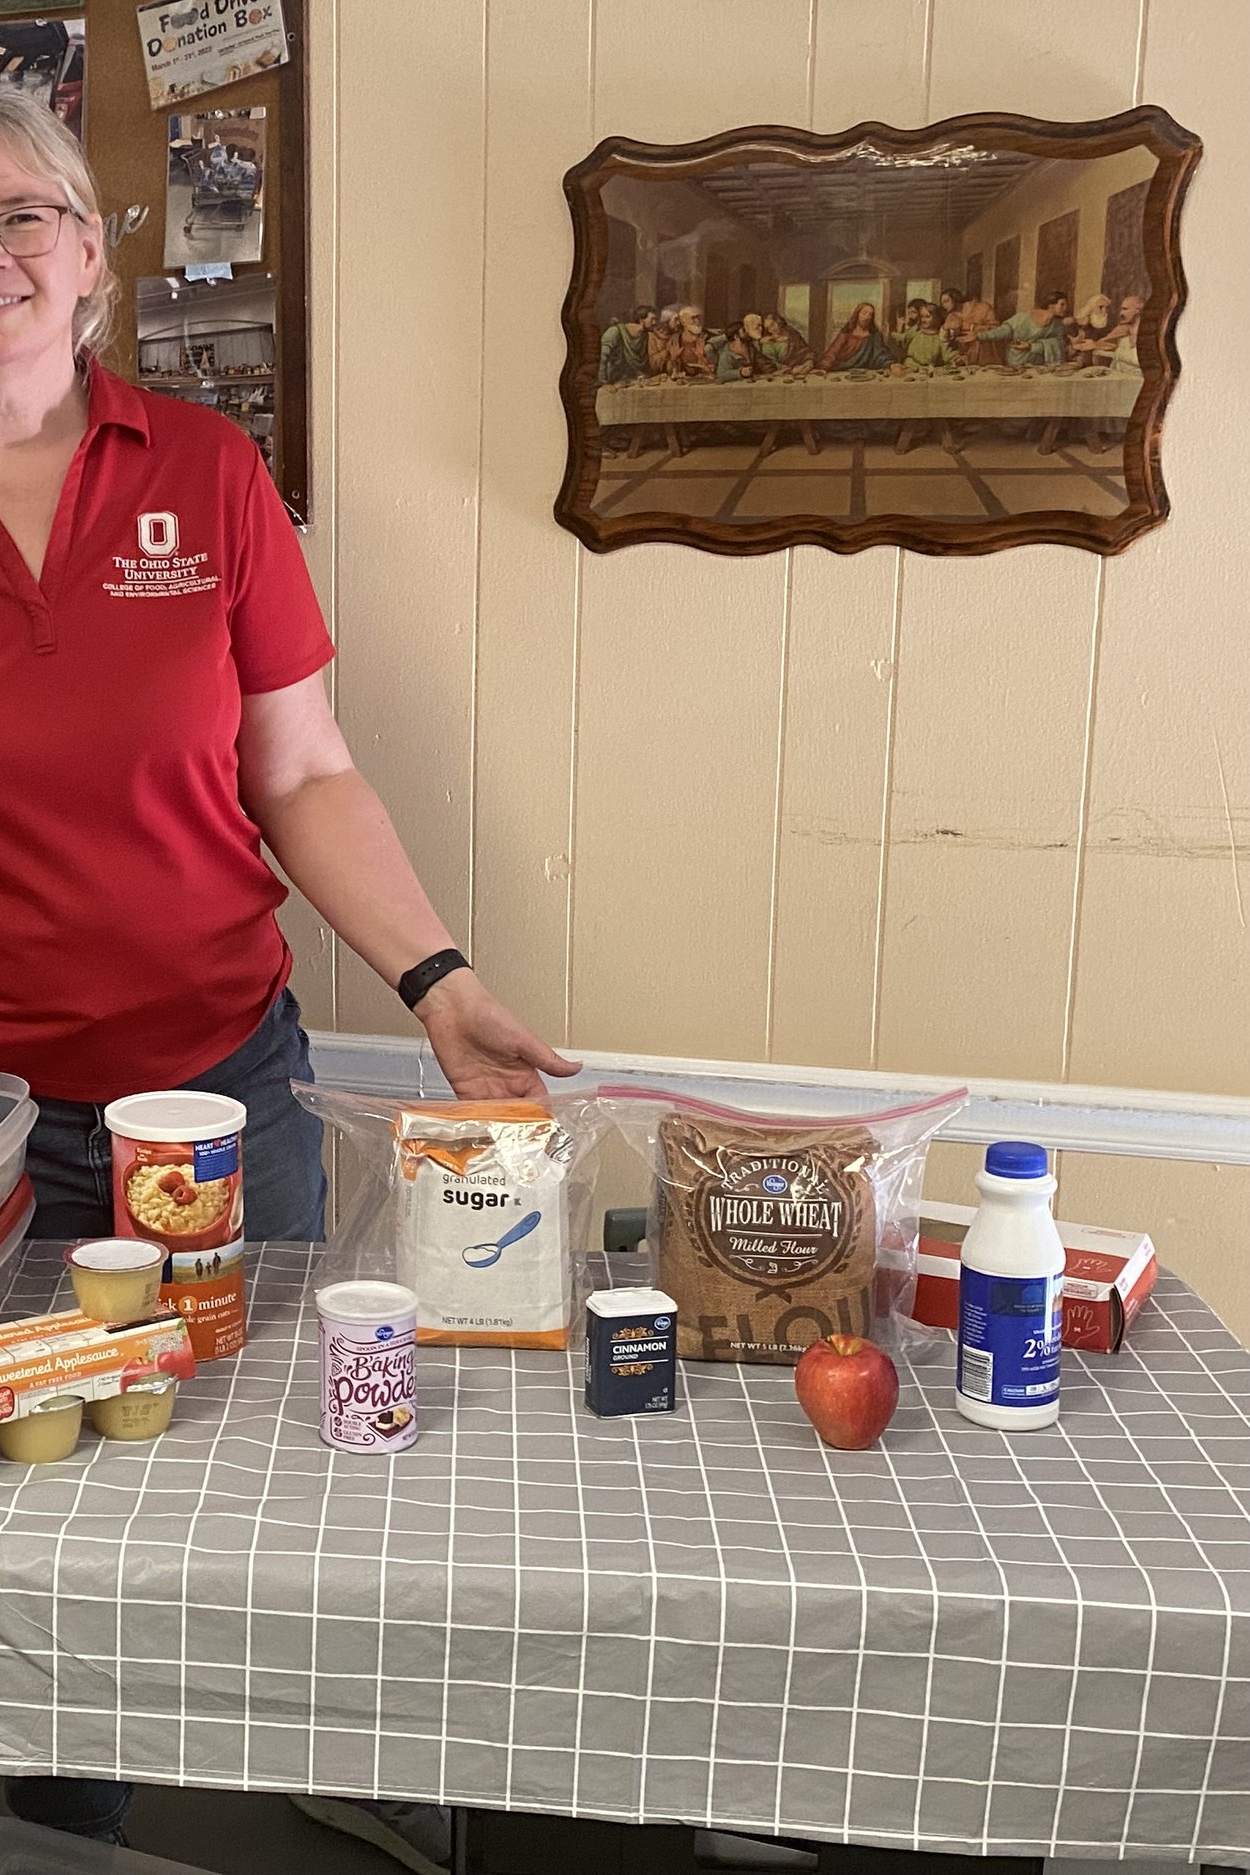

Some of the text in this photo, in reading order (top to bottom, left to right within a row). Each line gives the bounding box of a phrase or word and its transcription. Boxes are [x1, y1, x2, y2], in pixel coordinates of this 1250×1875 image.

[102, 583, 134, 591] COLLEGE
[125, 590, 182, 598] ENVIRONMENTAL
[183, 583, 216, 594] SCIENCES
[195, 1143, 214, 1151] HEART
[442, 1173, 506, 1186] granulated
[721, 1158, 828, 1194] TRADITIONAL
[766, 1178, 784, 1191] Kroger
[442, 1189, 509, 1211] sugar
[709, 1196, 842, 1238] WHOLE WHEAT
[729, 1237, 818, 1254] Milled Flour
[183, 1300, 193, 1311] 1
[199, 1293, 236, 1310] minute
[197, 1314, 216, 1324] grain
[442, 1316, 456, 1325] NET
[457, 1317, 469, 1325] WT
[469, 1317, 474, 1325] 4
[476, 1318, 484, 1326] LB
[613, 1341, 667, 1355] CINNAMON
[1023, 1339, 1051, 1358] 2%
[54, 1347, 119, 1372] Applesauce
[613, 1353, 639, 1361] GROUND
[65, 1372, 82, 1380] FOOD
